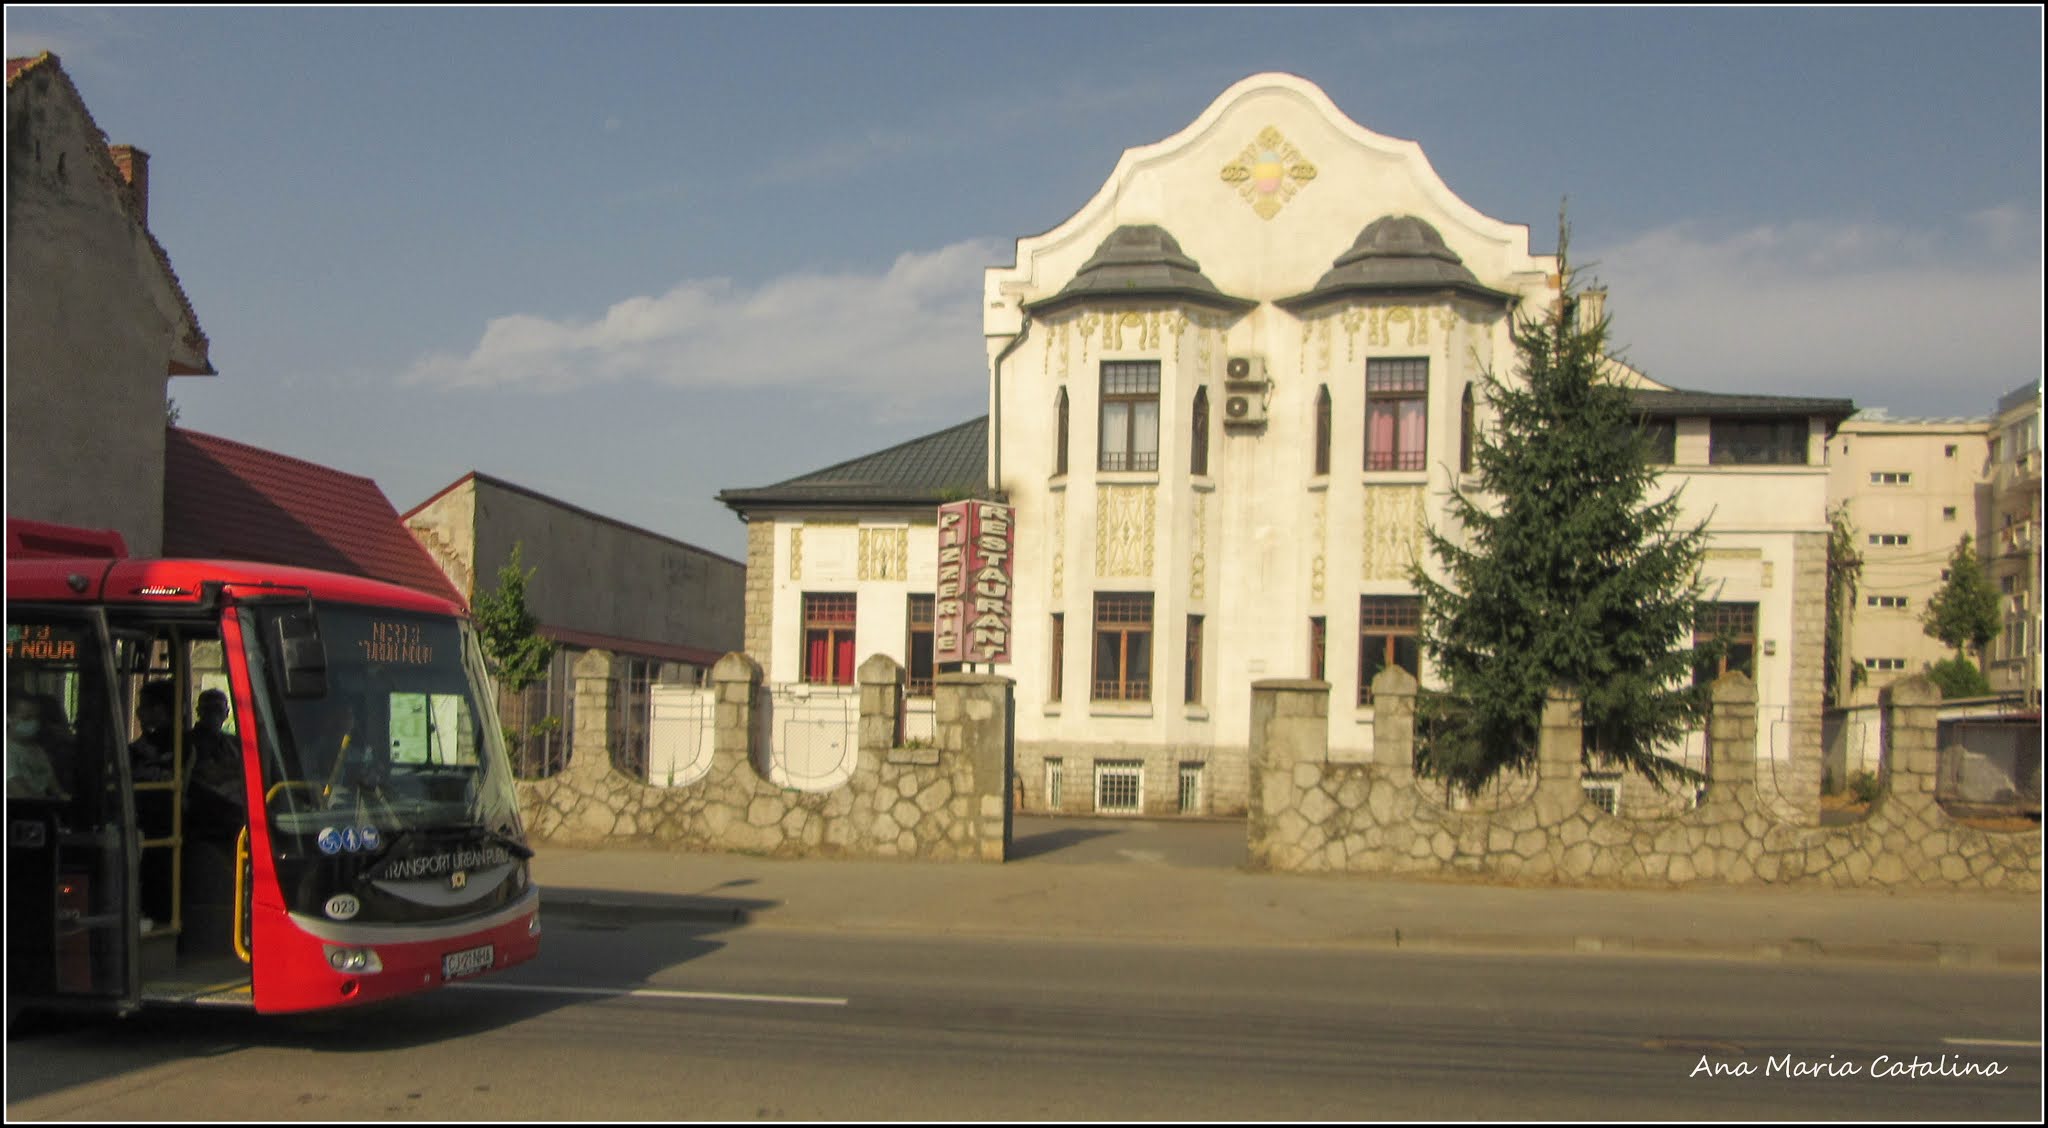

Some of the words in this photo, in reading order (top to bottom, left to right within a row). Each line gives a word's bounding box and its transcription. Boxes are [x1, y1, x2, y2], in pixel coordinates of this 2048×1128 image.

[938, 513, 961, 651] PIZZERIE
[972, 505, 1011, 659] RESTAURANT
[331, 899, 355, 914] 023
